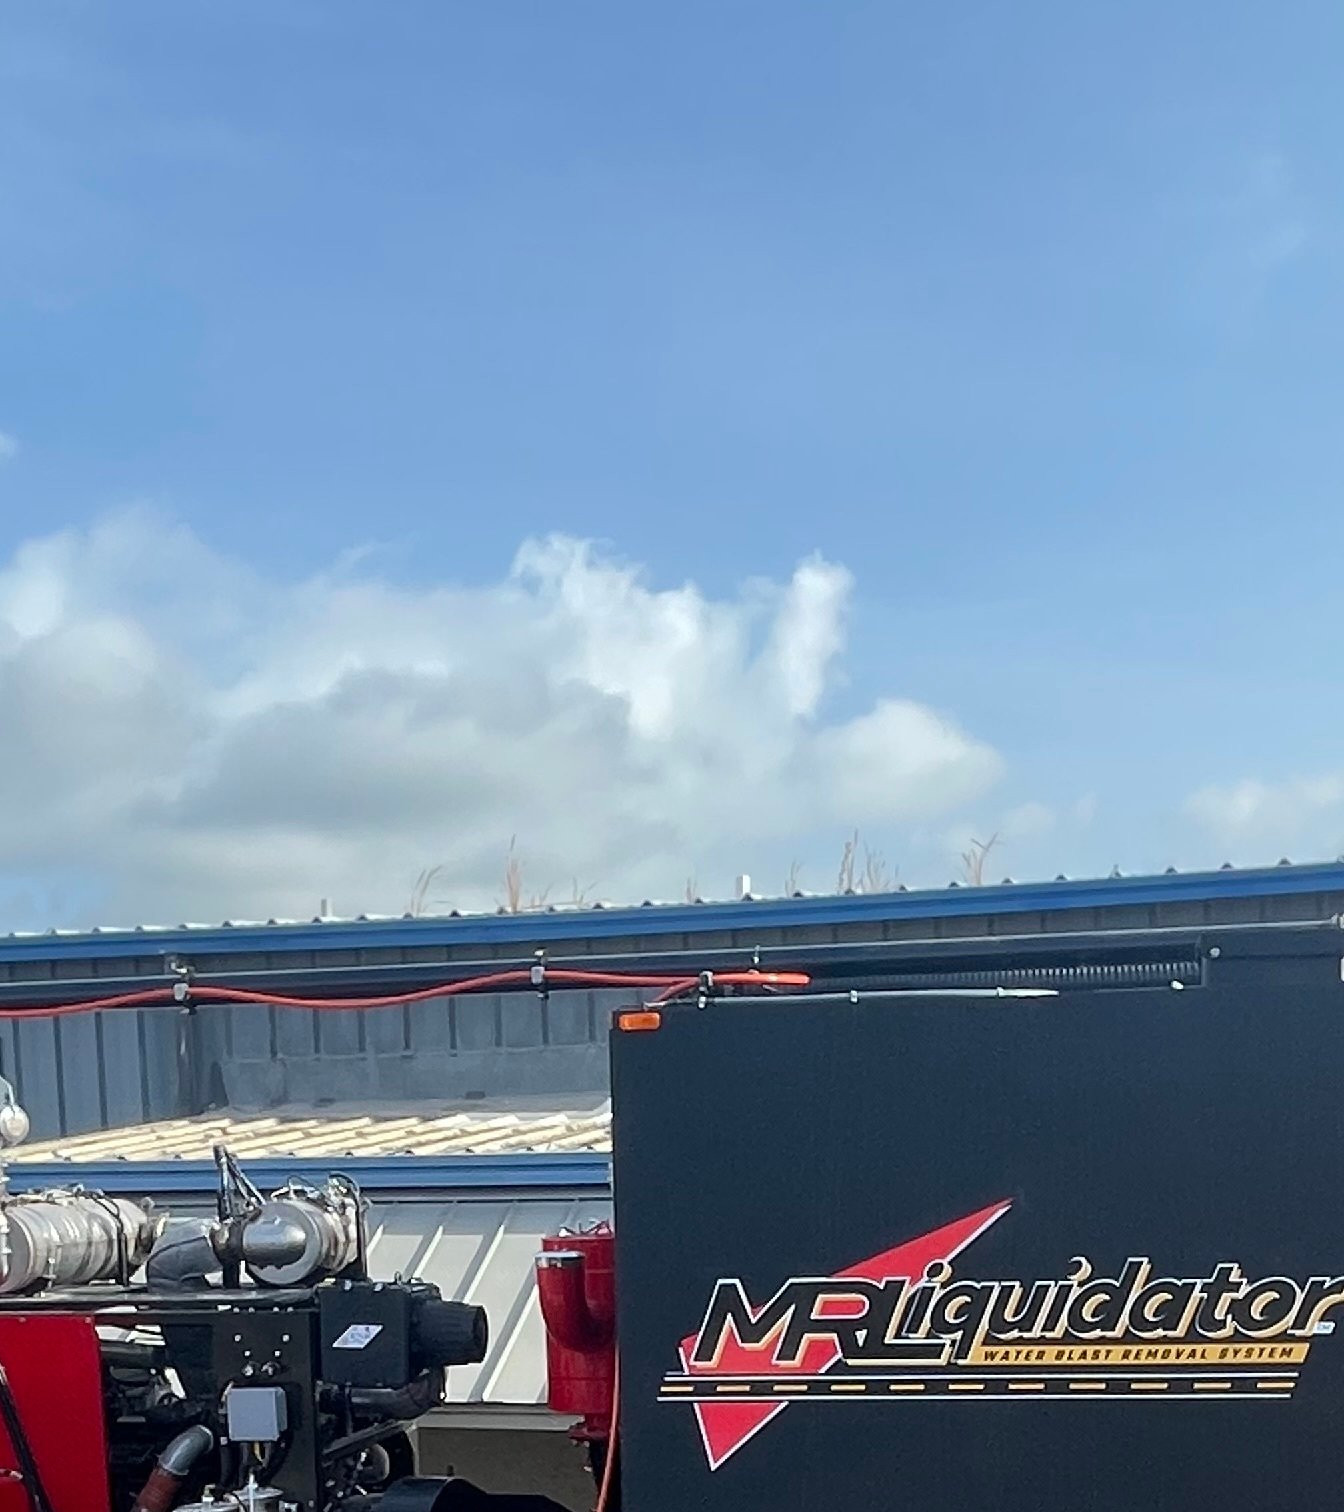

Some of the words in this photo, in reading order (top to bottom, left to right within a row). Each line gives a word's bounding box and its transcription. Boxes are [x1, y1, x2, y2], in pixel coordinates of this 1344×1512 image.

[982, 1349, 1045, 1362] WATER
[1055, 1348, 1113, 1361] BLAST
[1121, 1347, 1208, 1361] REMOVAL
[1218, 1346, 1295, 1360] SYSTEM
